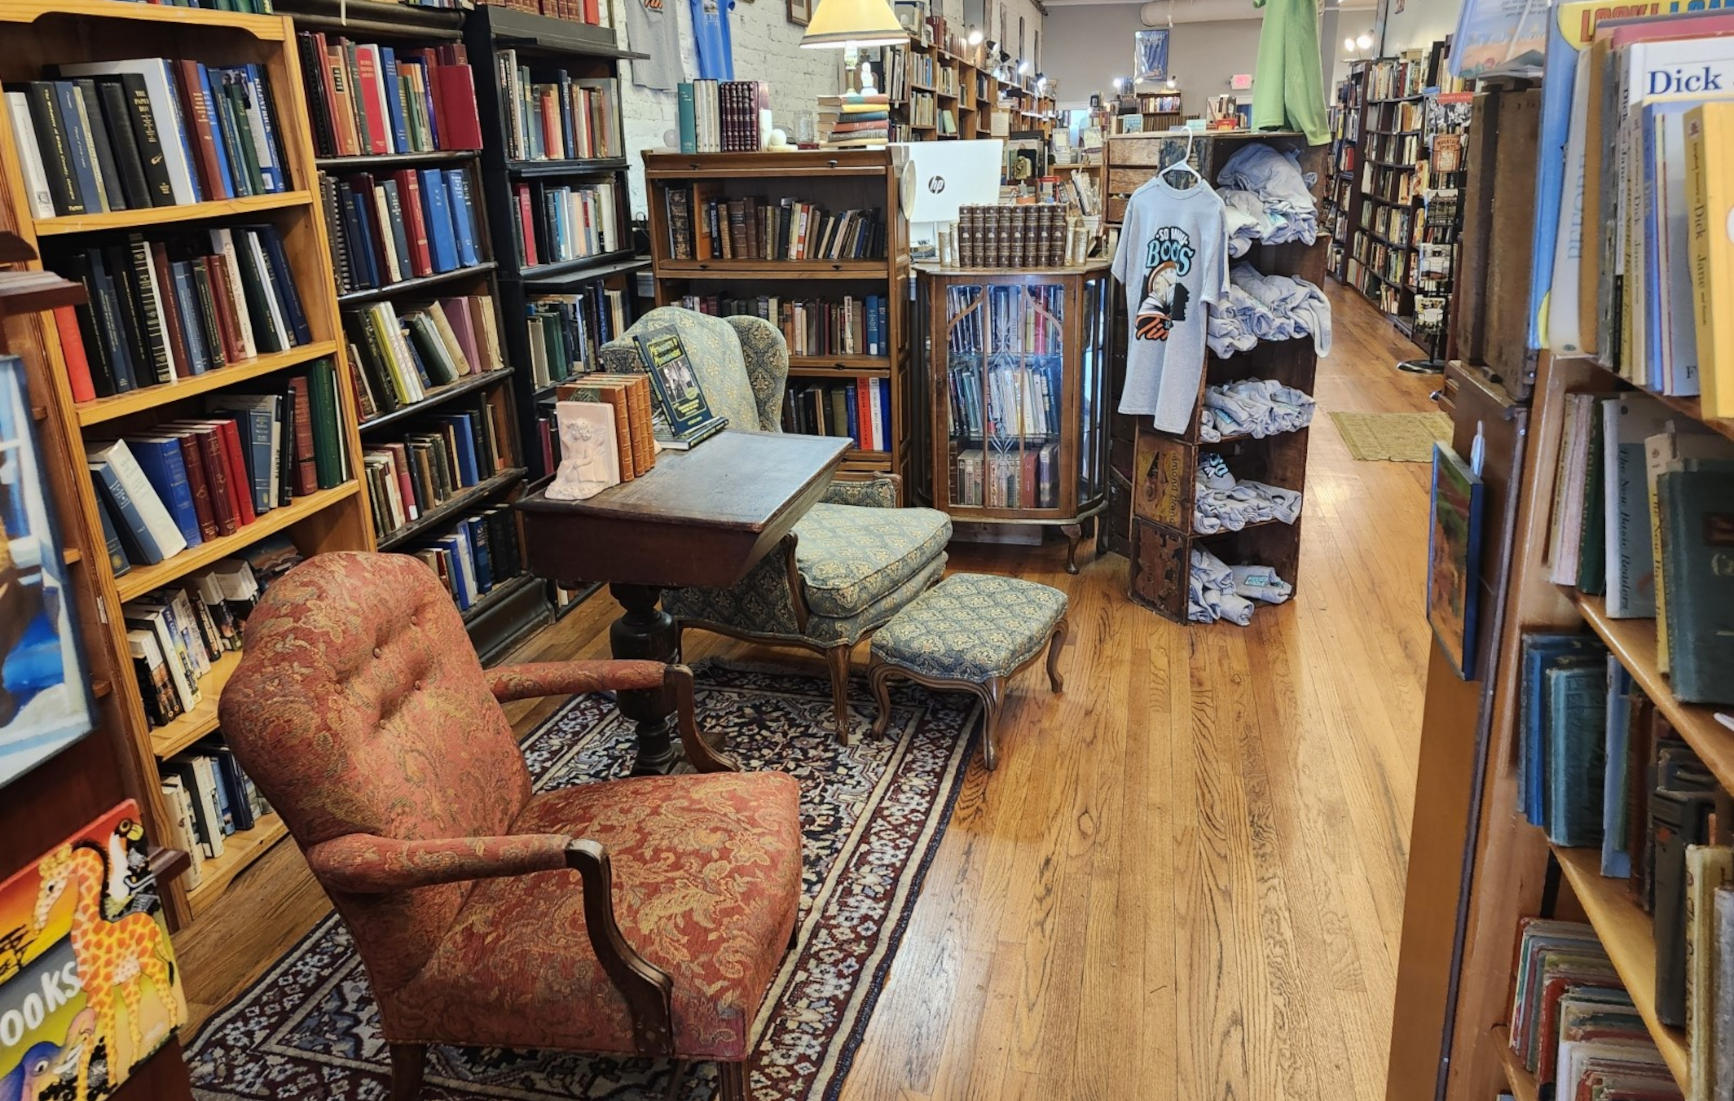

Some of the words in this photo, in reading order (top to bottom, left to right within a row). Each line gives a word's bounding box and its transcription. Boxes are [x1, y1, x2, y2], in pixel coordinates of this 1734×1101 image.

[1647, 66, 1722, 95] Dick
[929, 175, 945, 194] hp
[1158, 228, 1169, 241] SO
[1694, 204, 1706, 239] Dick
[1696, 254, 1707, 288] Jane
